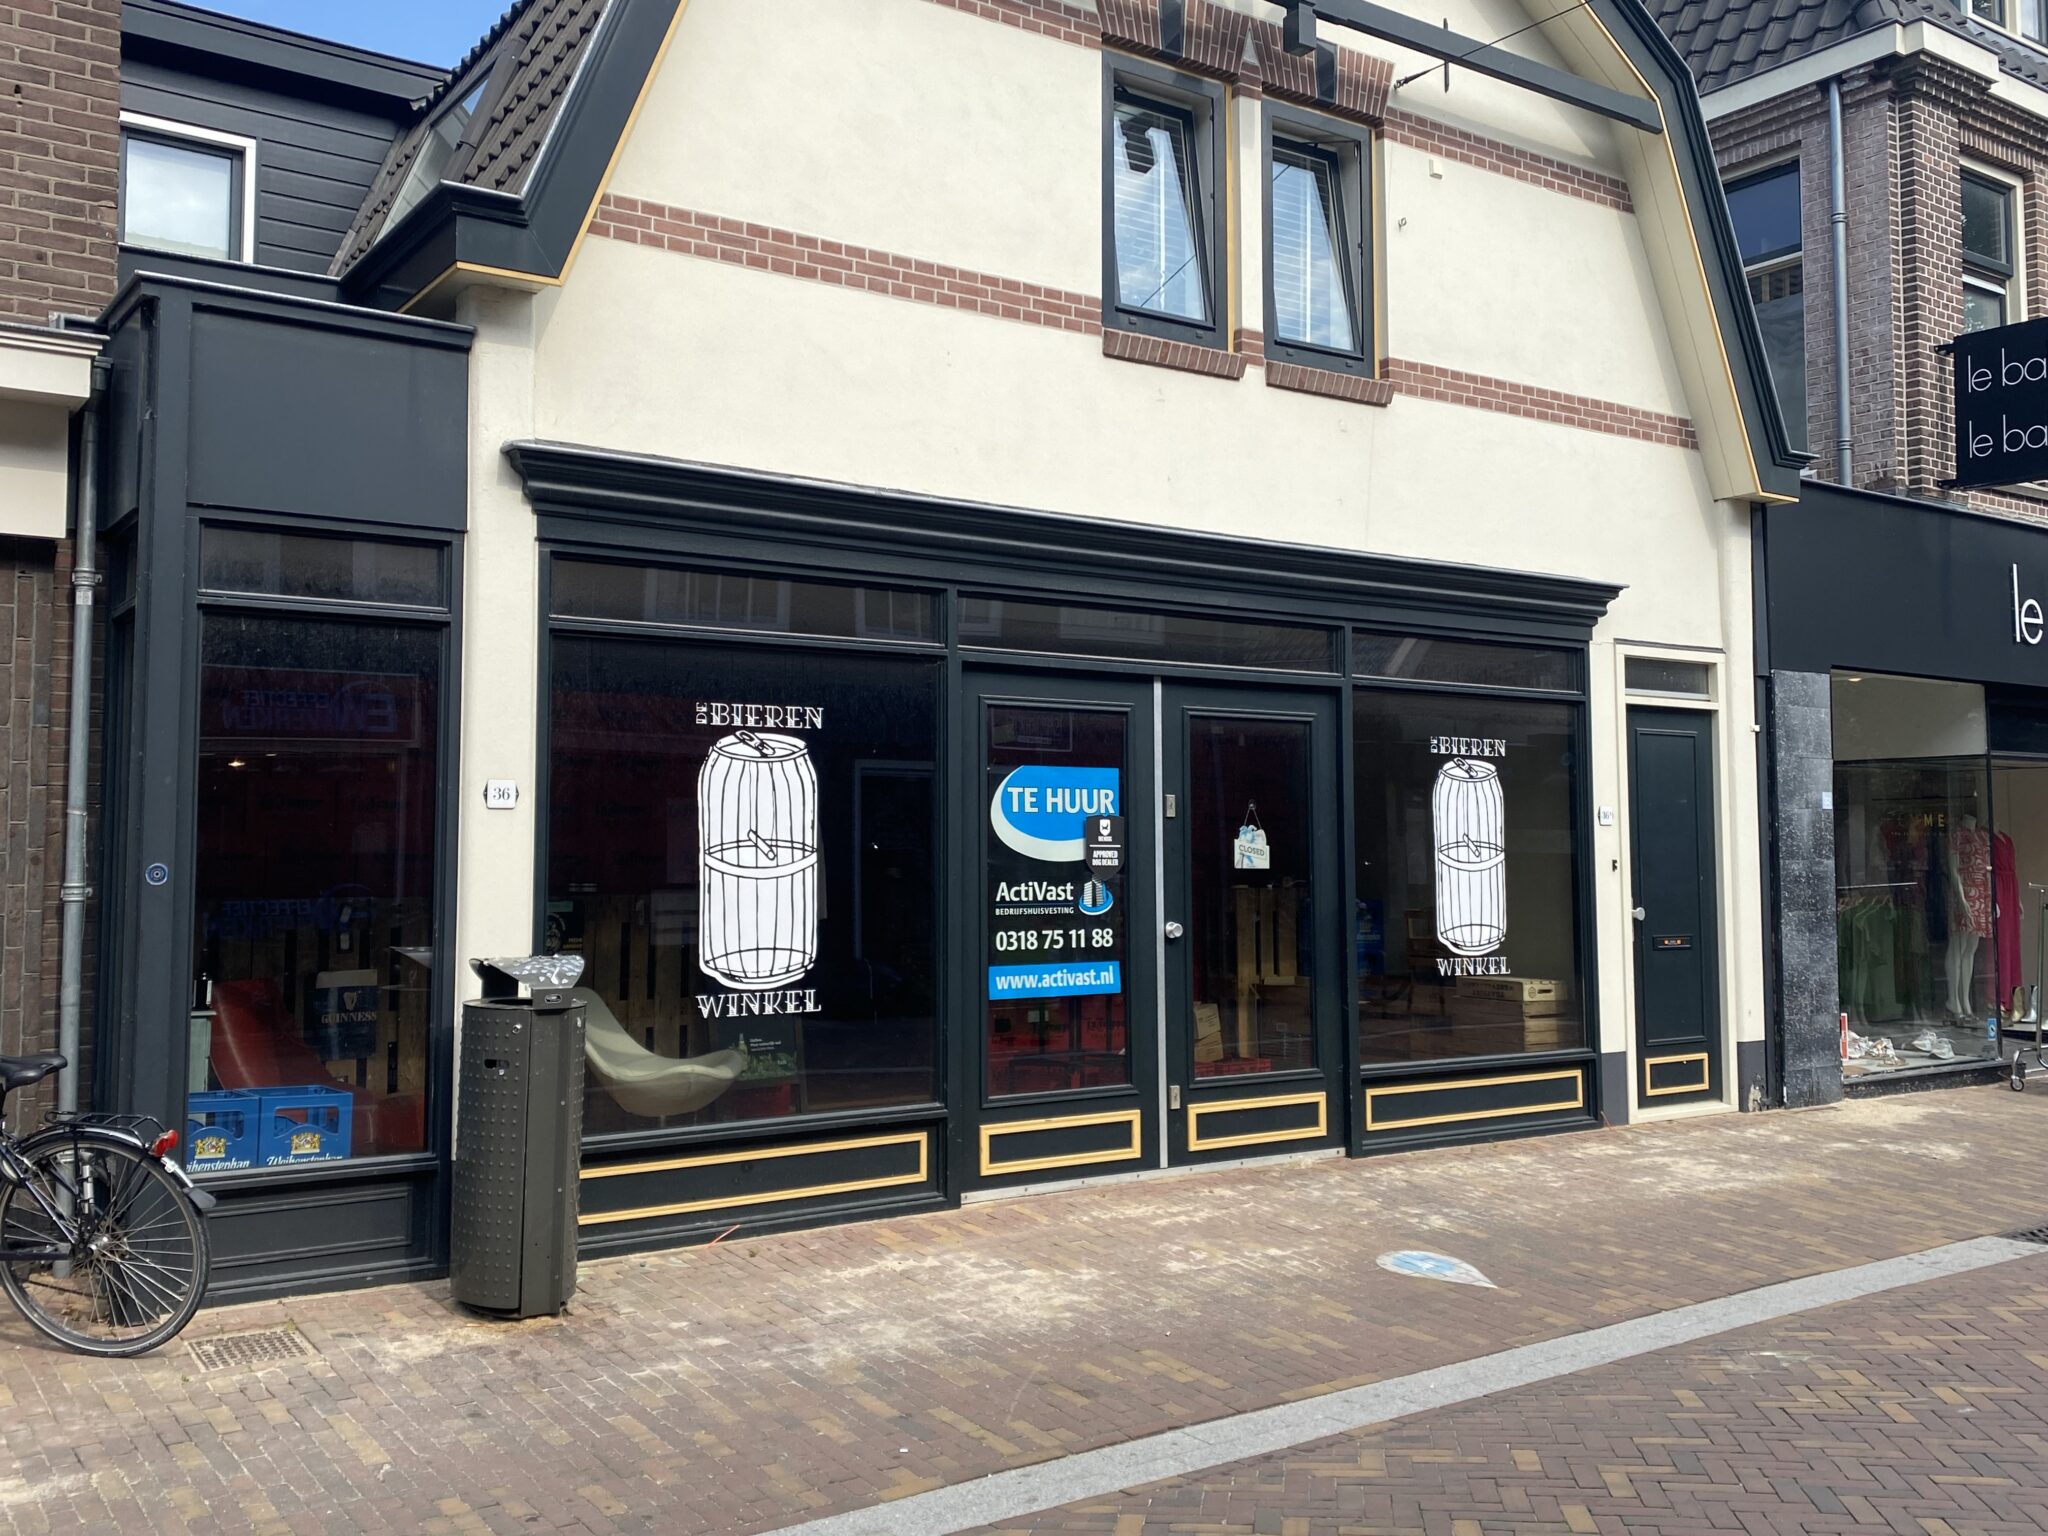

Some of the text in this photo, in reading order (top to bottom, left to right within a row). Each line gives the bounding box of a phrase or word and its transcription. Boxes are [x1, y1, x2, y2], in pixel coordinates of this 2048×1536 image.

[1967, 355, 1992, 393] le
[1969, 420, 1994, 458] le
[2012, 563, 2044, 645] le
[695, 702, 824, 729] DE BIEREN
[1439, 736, 1506, 757] BIEREN
[492, 787, 511, 800] 36
[1007, 786, 1116, 814] TE HUUR
[1239, 844, 1265, 857] CLOSED
[995, 881, 1074, 902] ActiVast
[995, 907, 1075, 916] BEDRIJFSHUISVESTING
[995, 928, 1114, 951] 0318 75 11 88
[995, 965, 1114, 990] www.activast.nl
[1436, 957, 1511, 977] WINKEL
[695, 990, 822, 1019] WINKEL
[321, 1011, 377, 1024] GUINNESS
